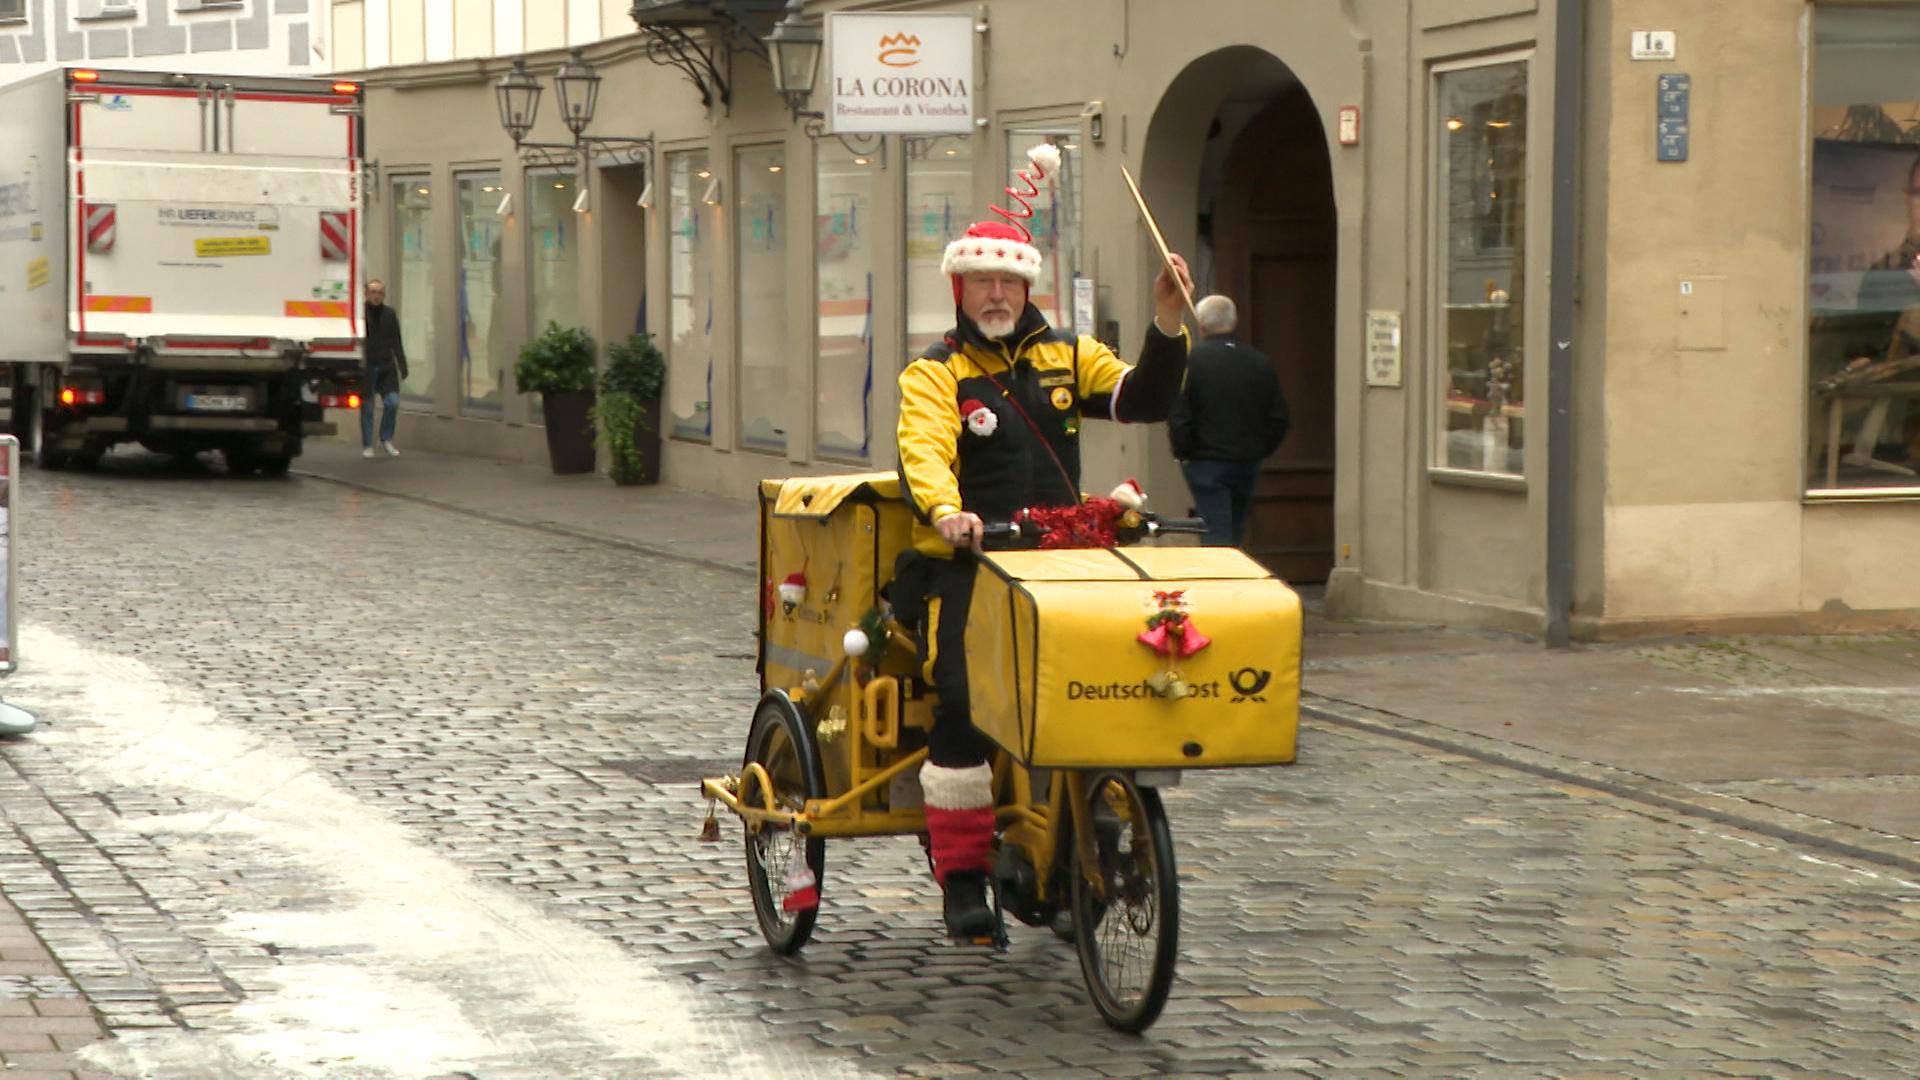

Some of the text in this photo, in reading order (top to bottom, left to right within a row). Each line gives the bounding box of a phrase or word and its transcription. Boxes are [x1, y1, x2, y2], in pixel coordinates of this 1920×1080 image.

[836, 77, 968, 97] LA CORONA
[836, 103, 968, 116] Restaurant & Vinothek
